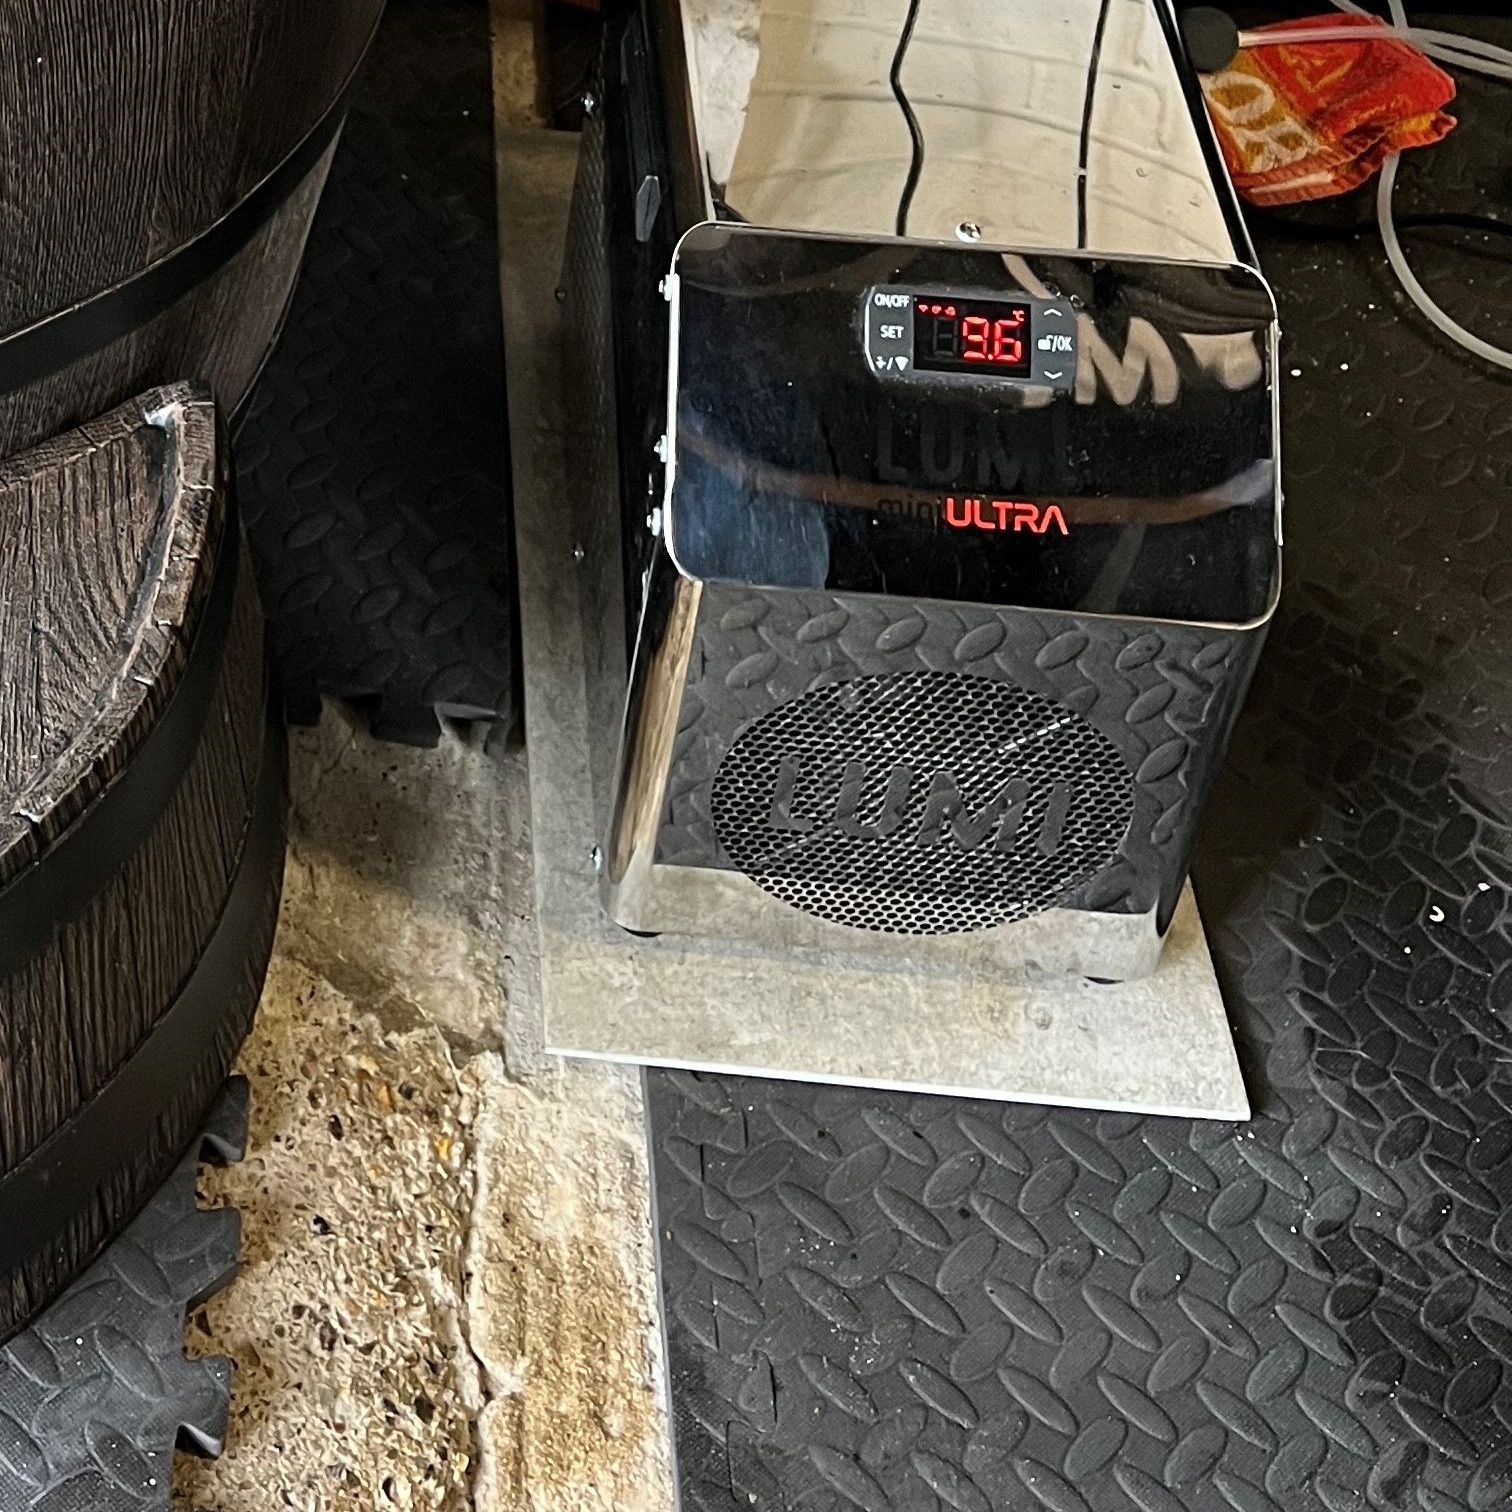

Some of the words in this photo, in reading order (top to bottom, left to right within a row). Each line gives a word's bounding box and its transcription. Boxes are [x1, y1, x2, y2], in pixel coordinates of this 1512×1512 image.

[874, 293, 910, 308] ON/OFF
[880, 325, 905, 339] SET
[876, 400, 1068, 492] LUMI
[767, 754, 1074, 858] LUMI
